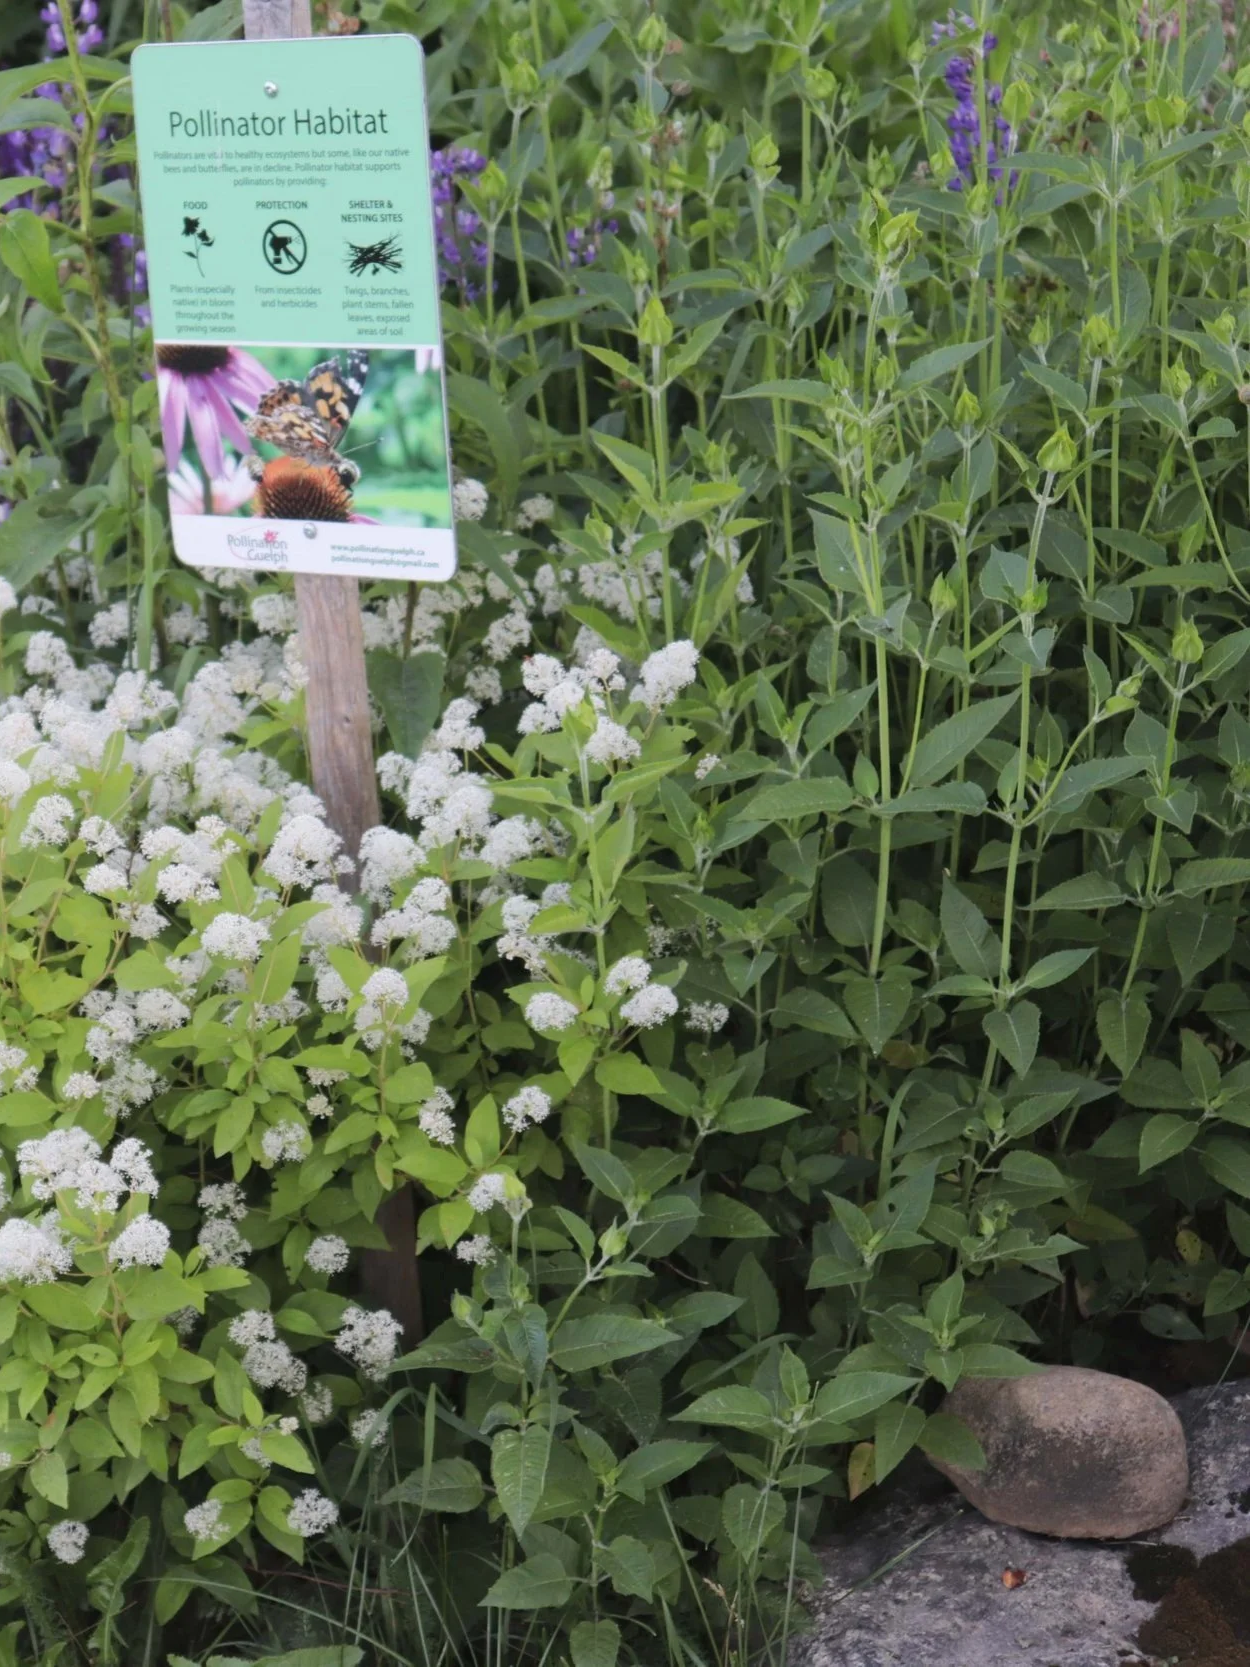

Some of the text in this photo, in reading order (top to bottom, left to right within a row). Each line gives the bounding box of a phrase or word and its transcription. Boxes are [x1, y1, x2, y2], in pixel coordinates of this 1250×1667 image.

[170, 107, 388, 137] Pollinator Habitat
[153, 151, 192, 160] Pollinators
[225, 150, 234, 159] to
[235, 149, 264, 160] healthy
[265, 150, 310, 160] ecosystems
[311, 149, 326, 158] but
[352, 148, 367, 157] like
[368, 149, 382, 157] our
[384, 147, 411, 157] native
[163, 164, 181, 173] bees
[182, 164, 197, 173] and
[240, 165, 253, 173] are
[253, 164, 261, 172] in
[295, 162, 332, 172] Pollinator
[334, 162, 363, 172] habitat
[365, 162, 402, 173] supports
[233, 178, 274, 188] pollinators
[275, 177, 285, 188] by
[183, 201, 208, 210] FOOD
[256, 201, 308, 210] PROTECTION
[349, 200, 393, 209] SHELTER &
[341, 213, 403, 223] NESTING SITES
[170, 284, 193, 293] Plants
[255, 285, 322, 295] From insecticides
[200, 298, 208, 306] in
[209, 298, 235, 307] bloom
[261, 299, 318, 308] and herbicides
[342, 300, 363, 310] plant
[391, 300, 414, 309] fallen
[175, 310, 234, 321] throughout the
[376, 314, 411, 324] exposed
[175, 324, 236, 334] growing season
[357, 327, 403, 336] areas of soil
[227, 533, 288, 551] Pollination
[247, 549, 288, 565] Guelph
